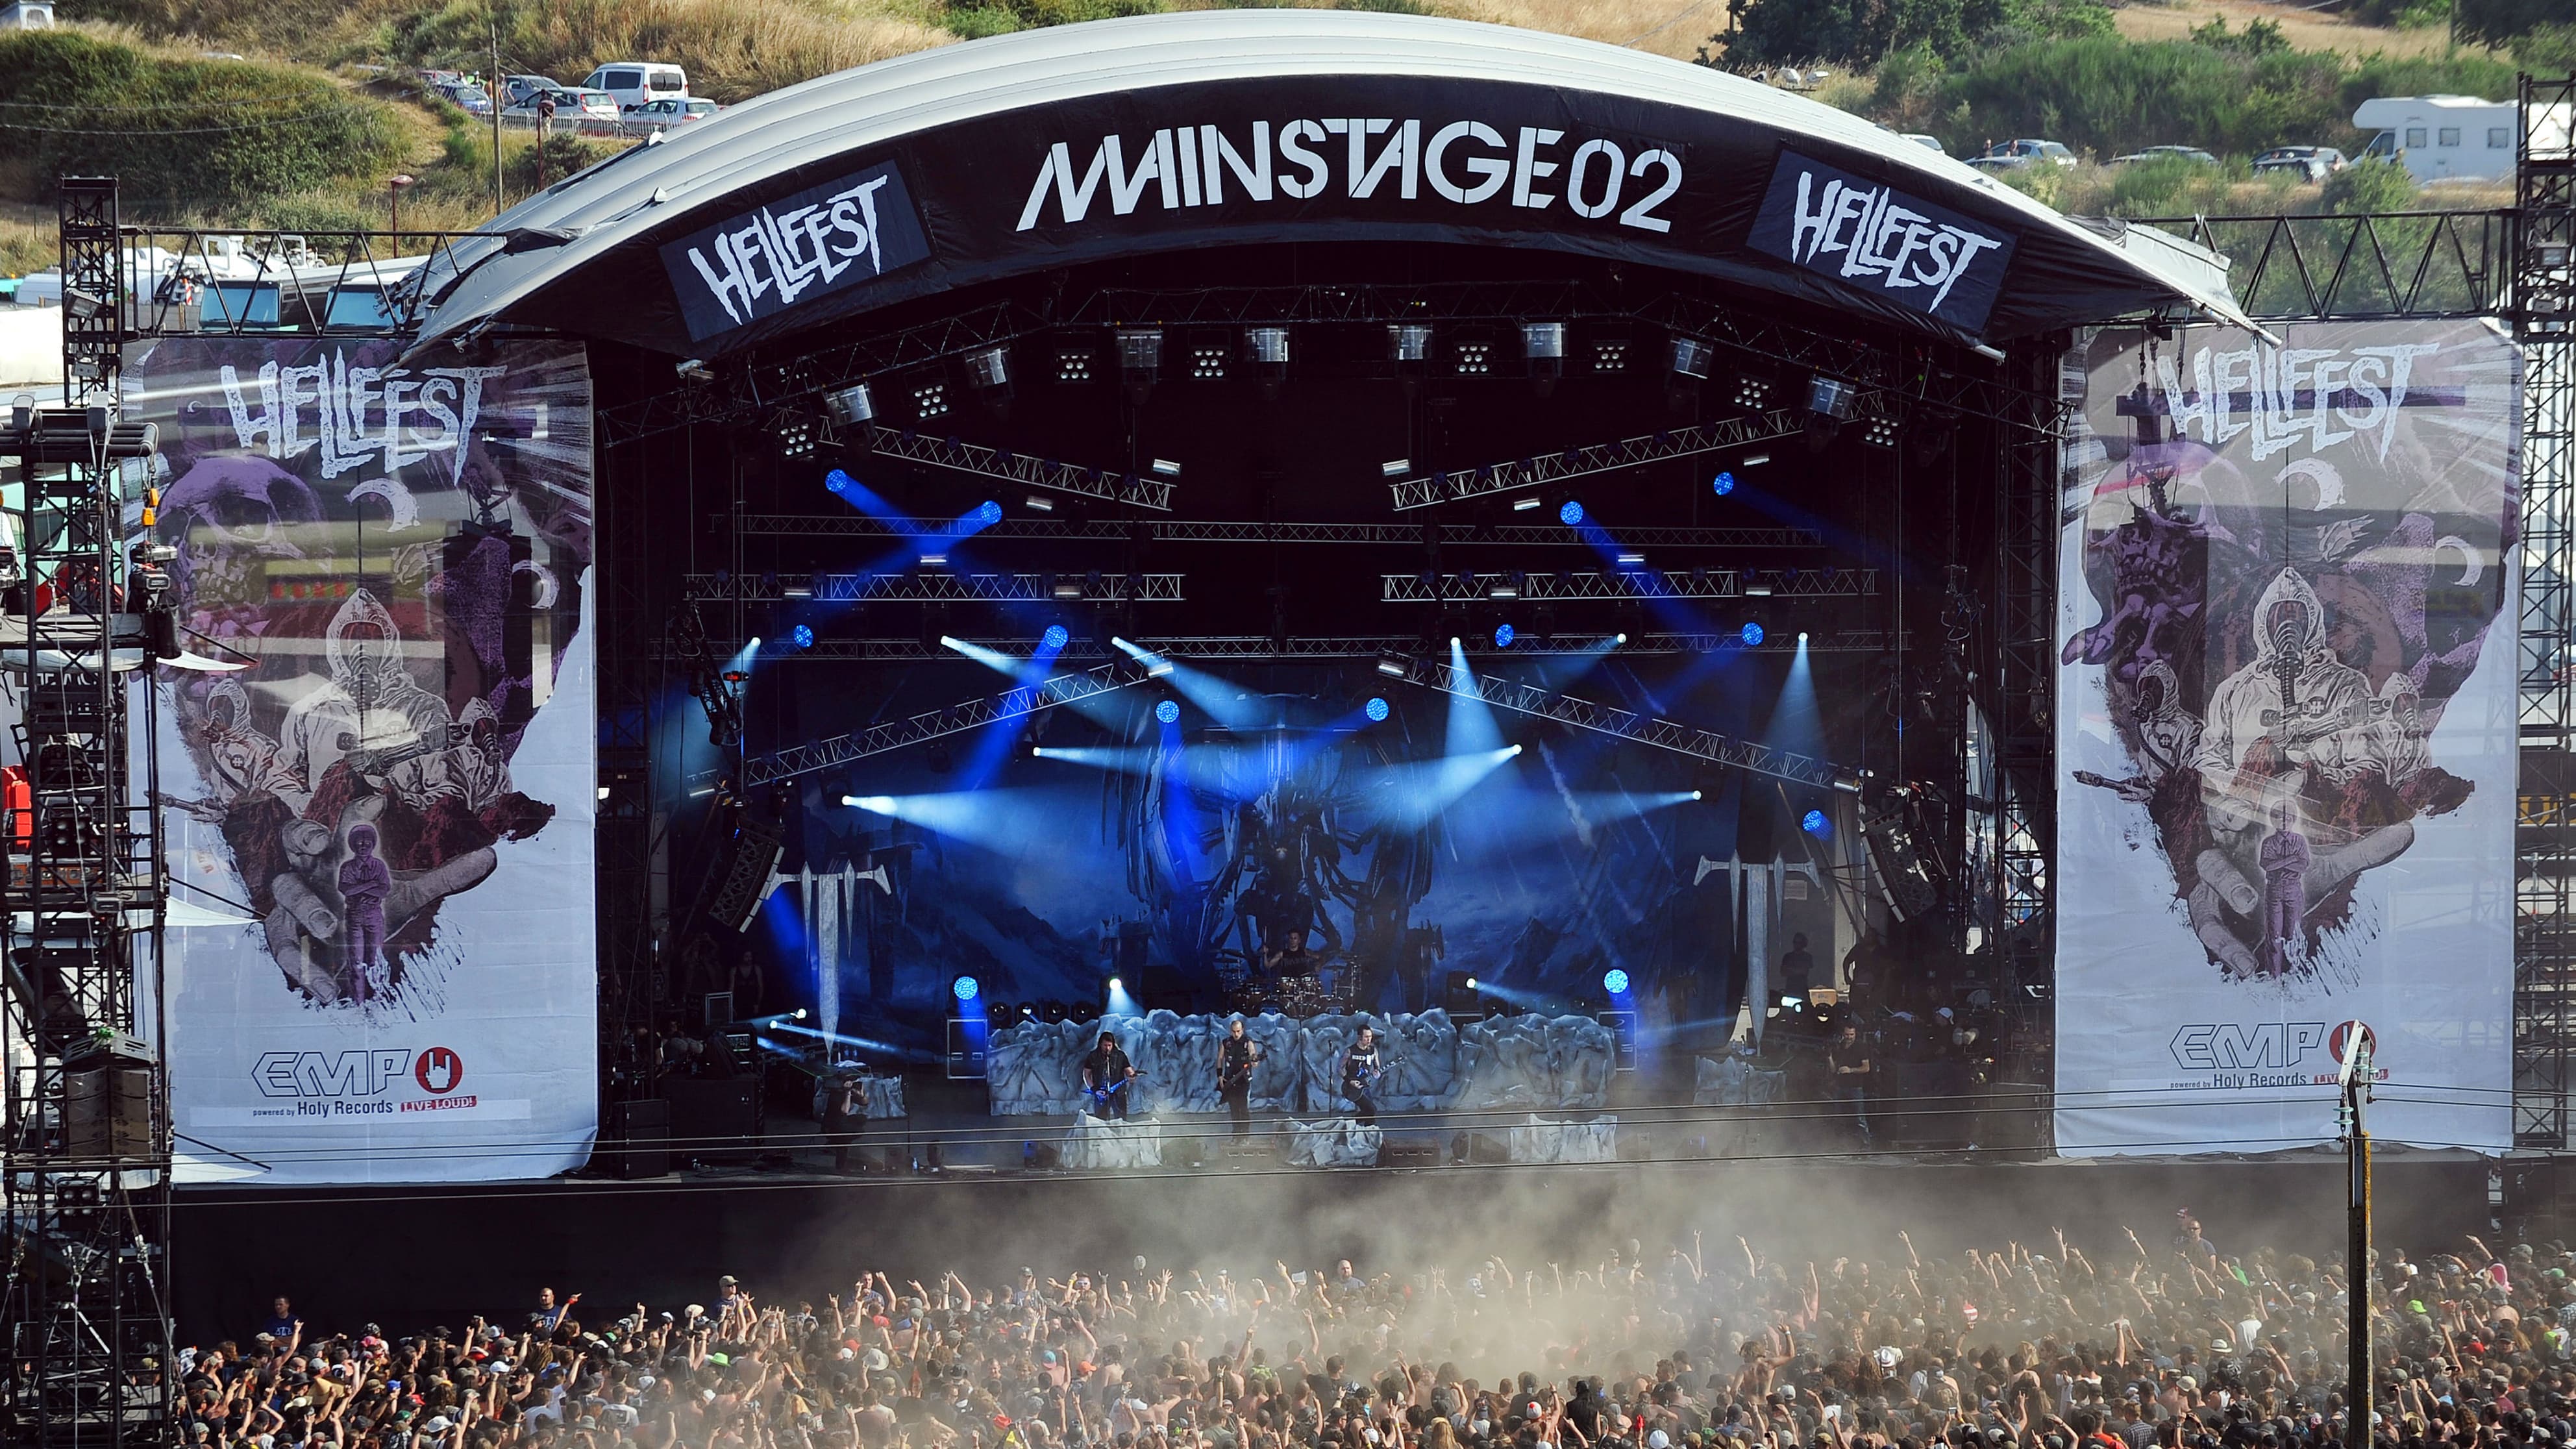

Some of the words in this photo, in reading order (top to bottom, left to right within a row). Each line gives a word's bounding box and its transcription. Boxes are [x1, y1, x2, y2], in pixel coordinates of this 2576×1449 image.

[1016, 118, 1565, 231] MAINSTAGE
[1567, 138, 1683, 233] 02
[687, 174, 888, 326] HELLFEST
[1792, 171, 2002, 314] HELLFEST
[221, 345, 508, 486] HELLFEST
[2157, 341, 2440, 464] HELLFEST
[251, 1048, 411, 1097] EMP
[2170, 1022, 2325, 1069] EMP
[2170, 1080, 2201, 1089] powered
[2214, 1072, 2244, 1090] Holy
[2249, 1072, 2306, 1087] Records
[297, 1101, 329, 1118] Holy
[334, 1099, 393, 1115] Records
[404, 1100, 433, 1112] LIVE
[436, 1097, 473, 1109] LOUD!
